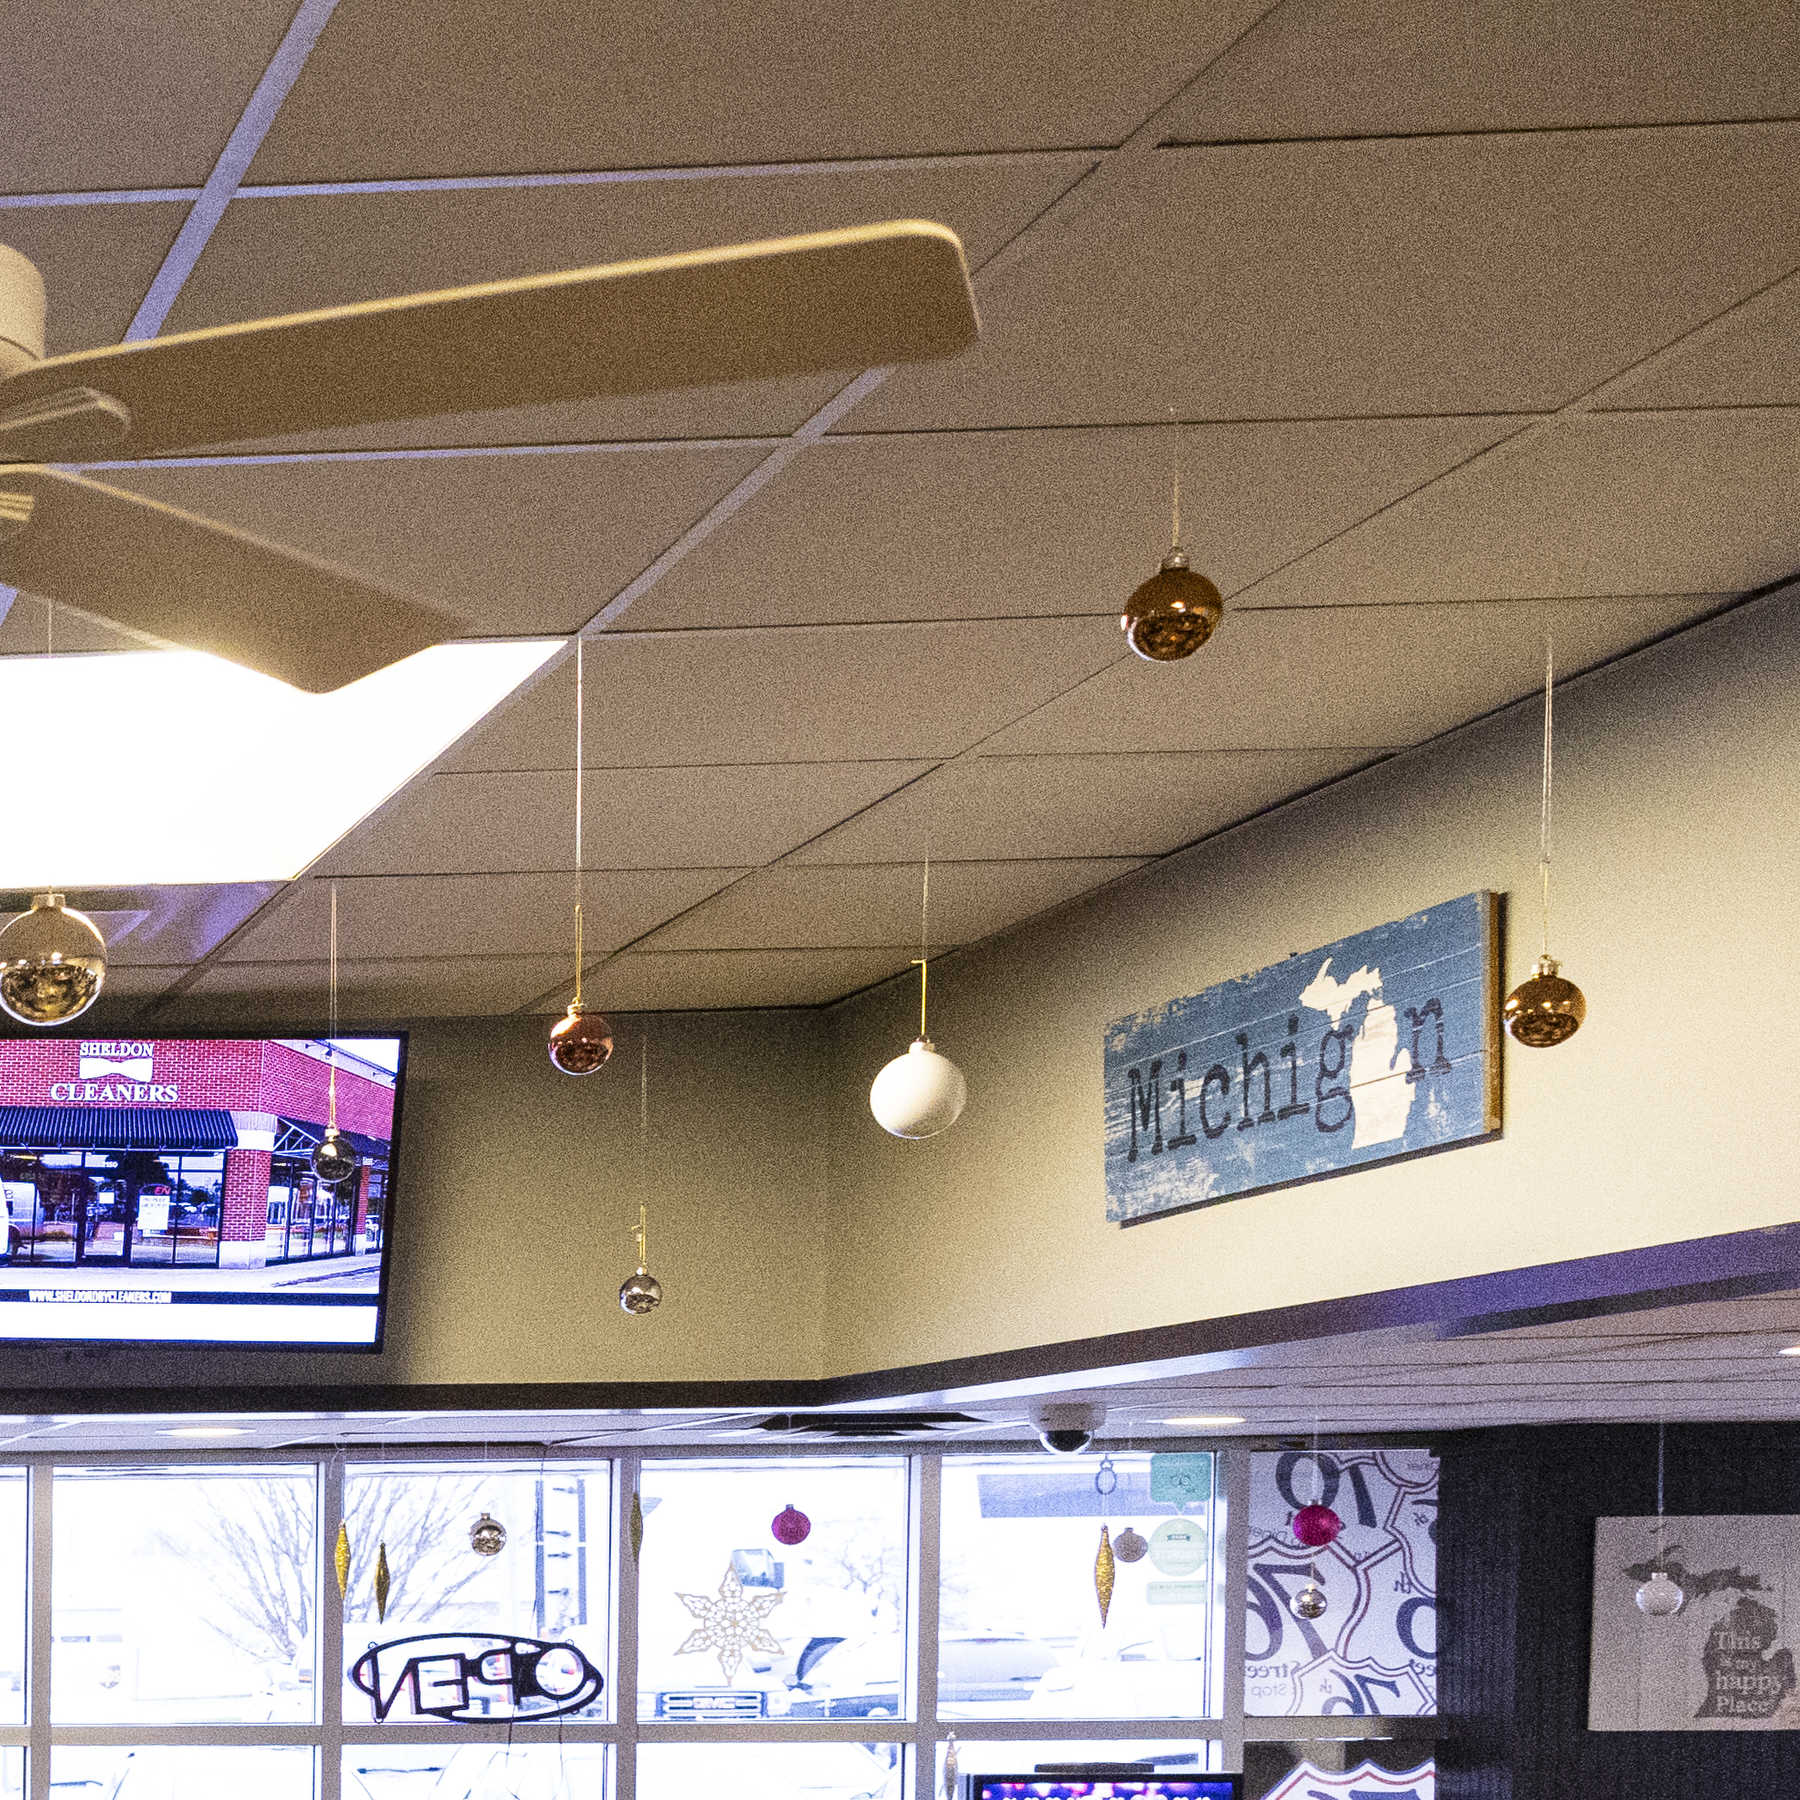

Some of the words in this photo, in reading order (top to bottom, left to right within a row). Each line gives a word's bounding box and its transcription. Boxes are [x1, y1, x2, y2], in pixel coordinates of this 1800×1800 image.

[80, 1042, 154, 1057] SHELDON
[1127, 998, 1451, 1163] Michign
[51, 1083, 178, 1102] CLEANERS
[1716, 1671, 1782, 1697] happy
